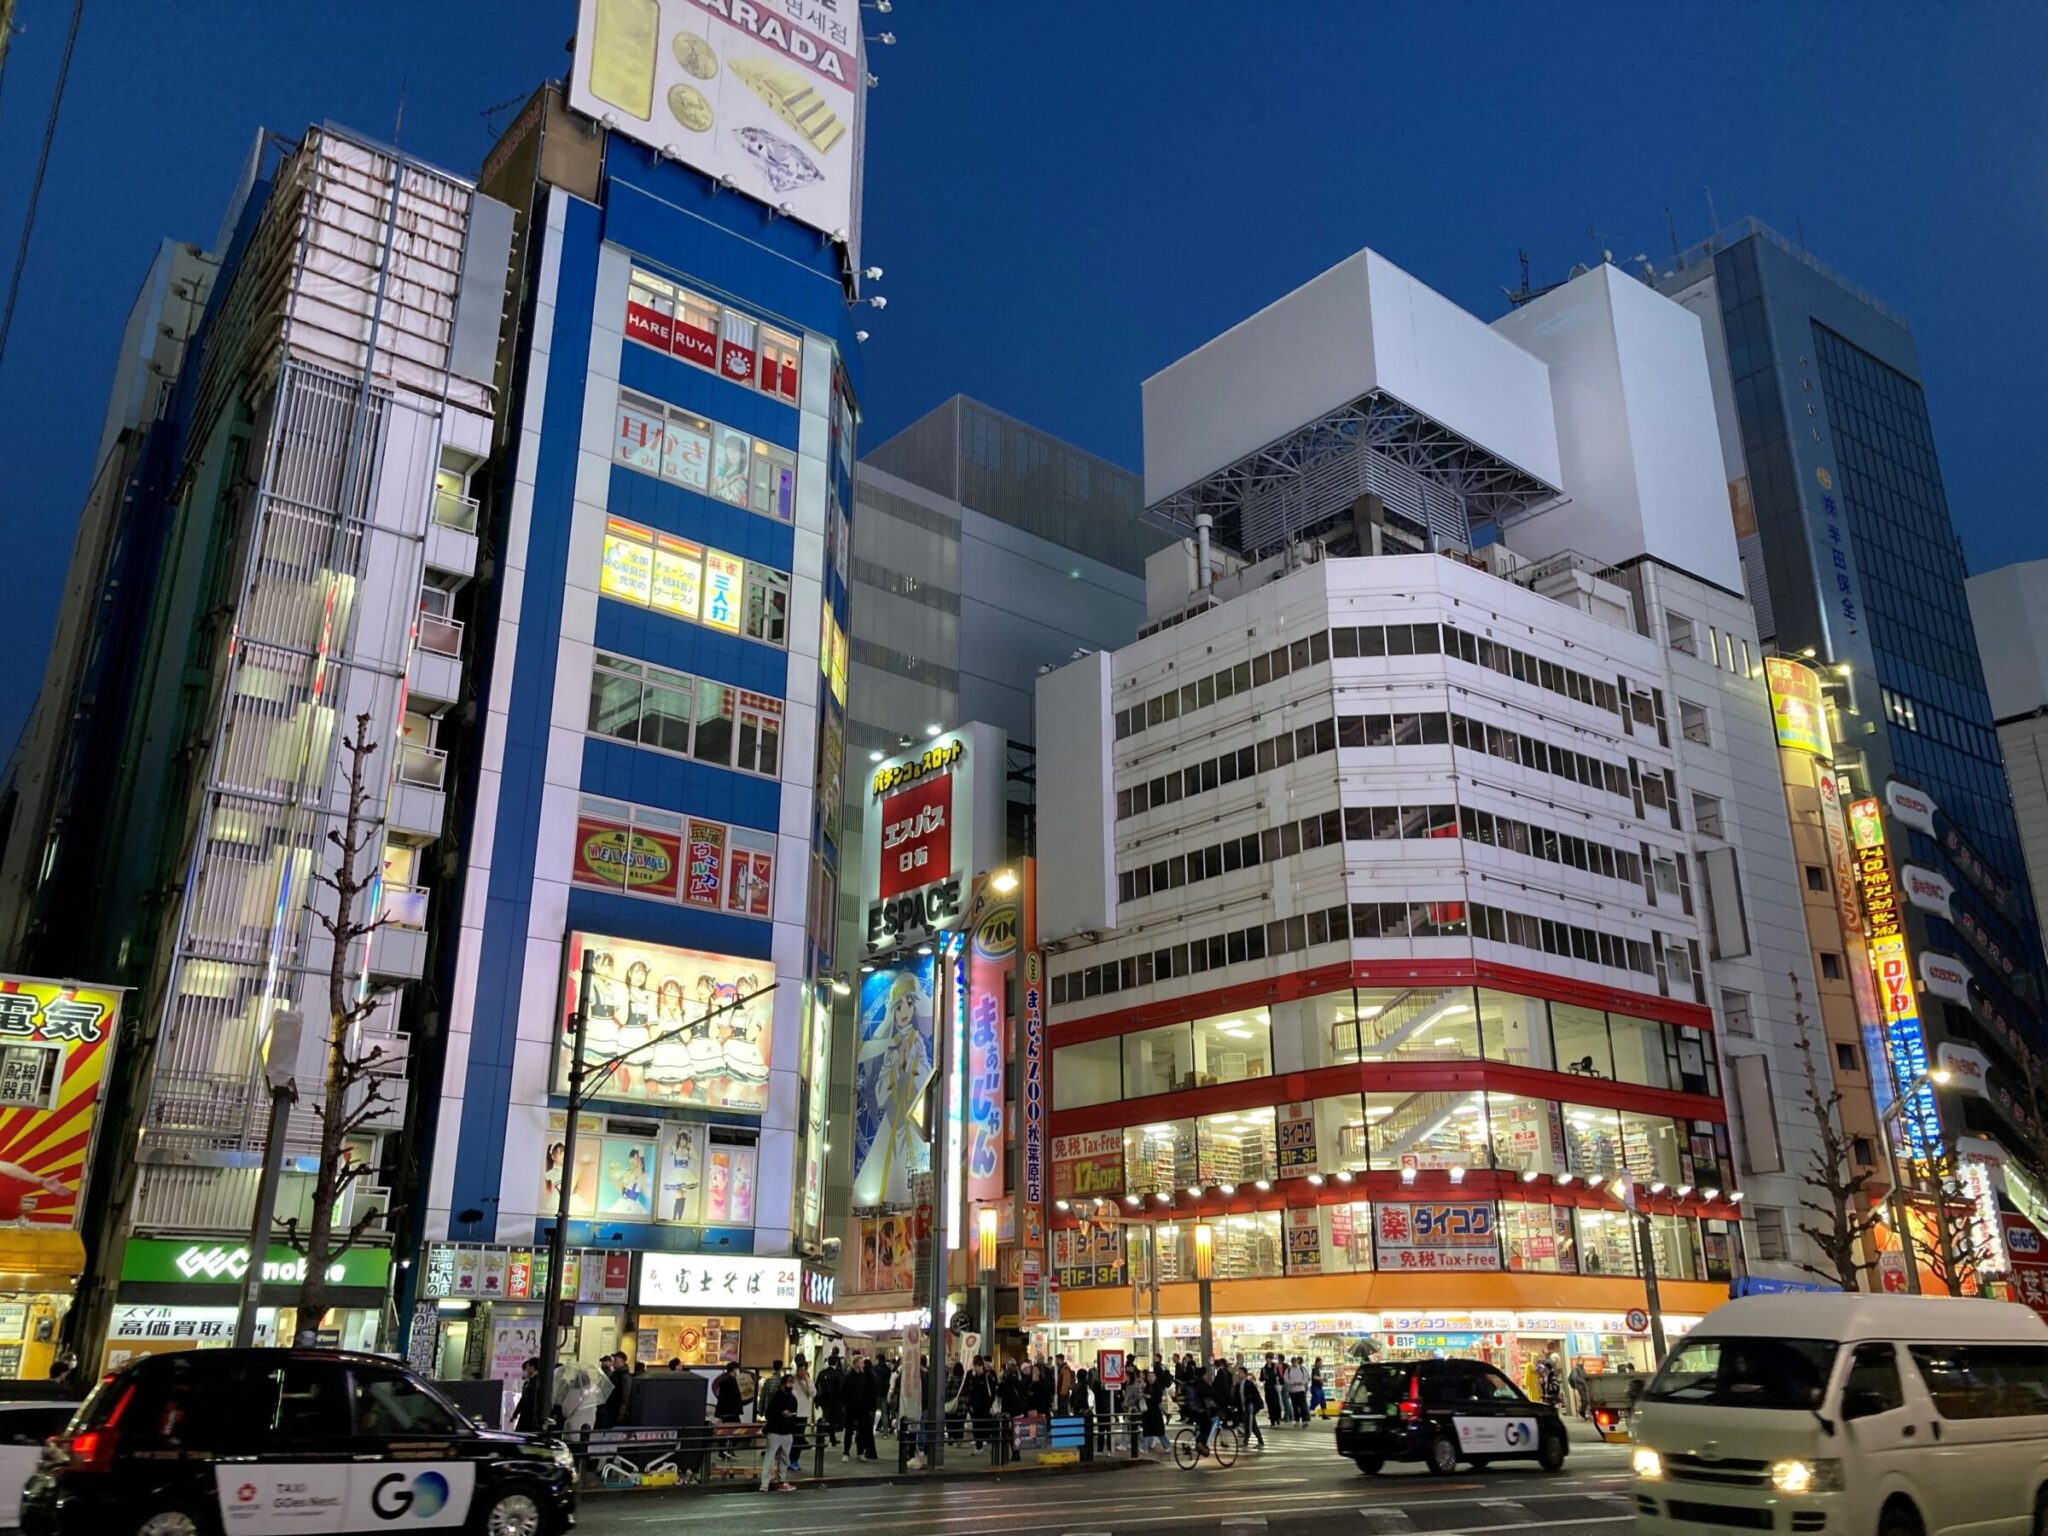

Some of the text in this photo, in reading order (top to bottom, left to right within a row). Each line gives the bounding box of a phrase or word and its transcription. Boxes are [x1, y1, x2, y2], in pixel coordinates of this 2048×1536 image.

[709, 556, 737, 575] 麻雀
[883, 805, 946, 849] エスパス
[1860, 847, 1884, 859] ゲーム
[1863, 860, 1883, 872] CD
[1866, 885, 1891, 898] アニメ
[867, 880, 959, 942] ESPACE
[1868, 898, 1893, 911] コミック
[1883, 960, 1911, 1015] DVD
[0, 992, 102, 1042] 電気
[1055, 1134, 1121, 1158] 免税 Tax-Free
[1382, 1205, 1409, 1240] 薬
[1414, 1207, 1490, 1236] ダイコク
[2009, 1230, 2038, 1250] GiGO
[1400, 1250, 1496, 1267] 免税 Tax-Free
[675, 1268, 765, 1294] 富士そば
[778, 1271, 796, 1283] 24
[776, 1286, 796, 1297] 時間
[1397, 1336, 1414, 1347] B1F
